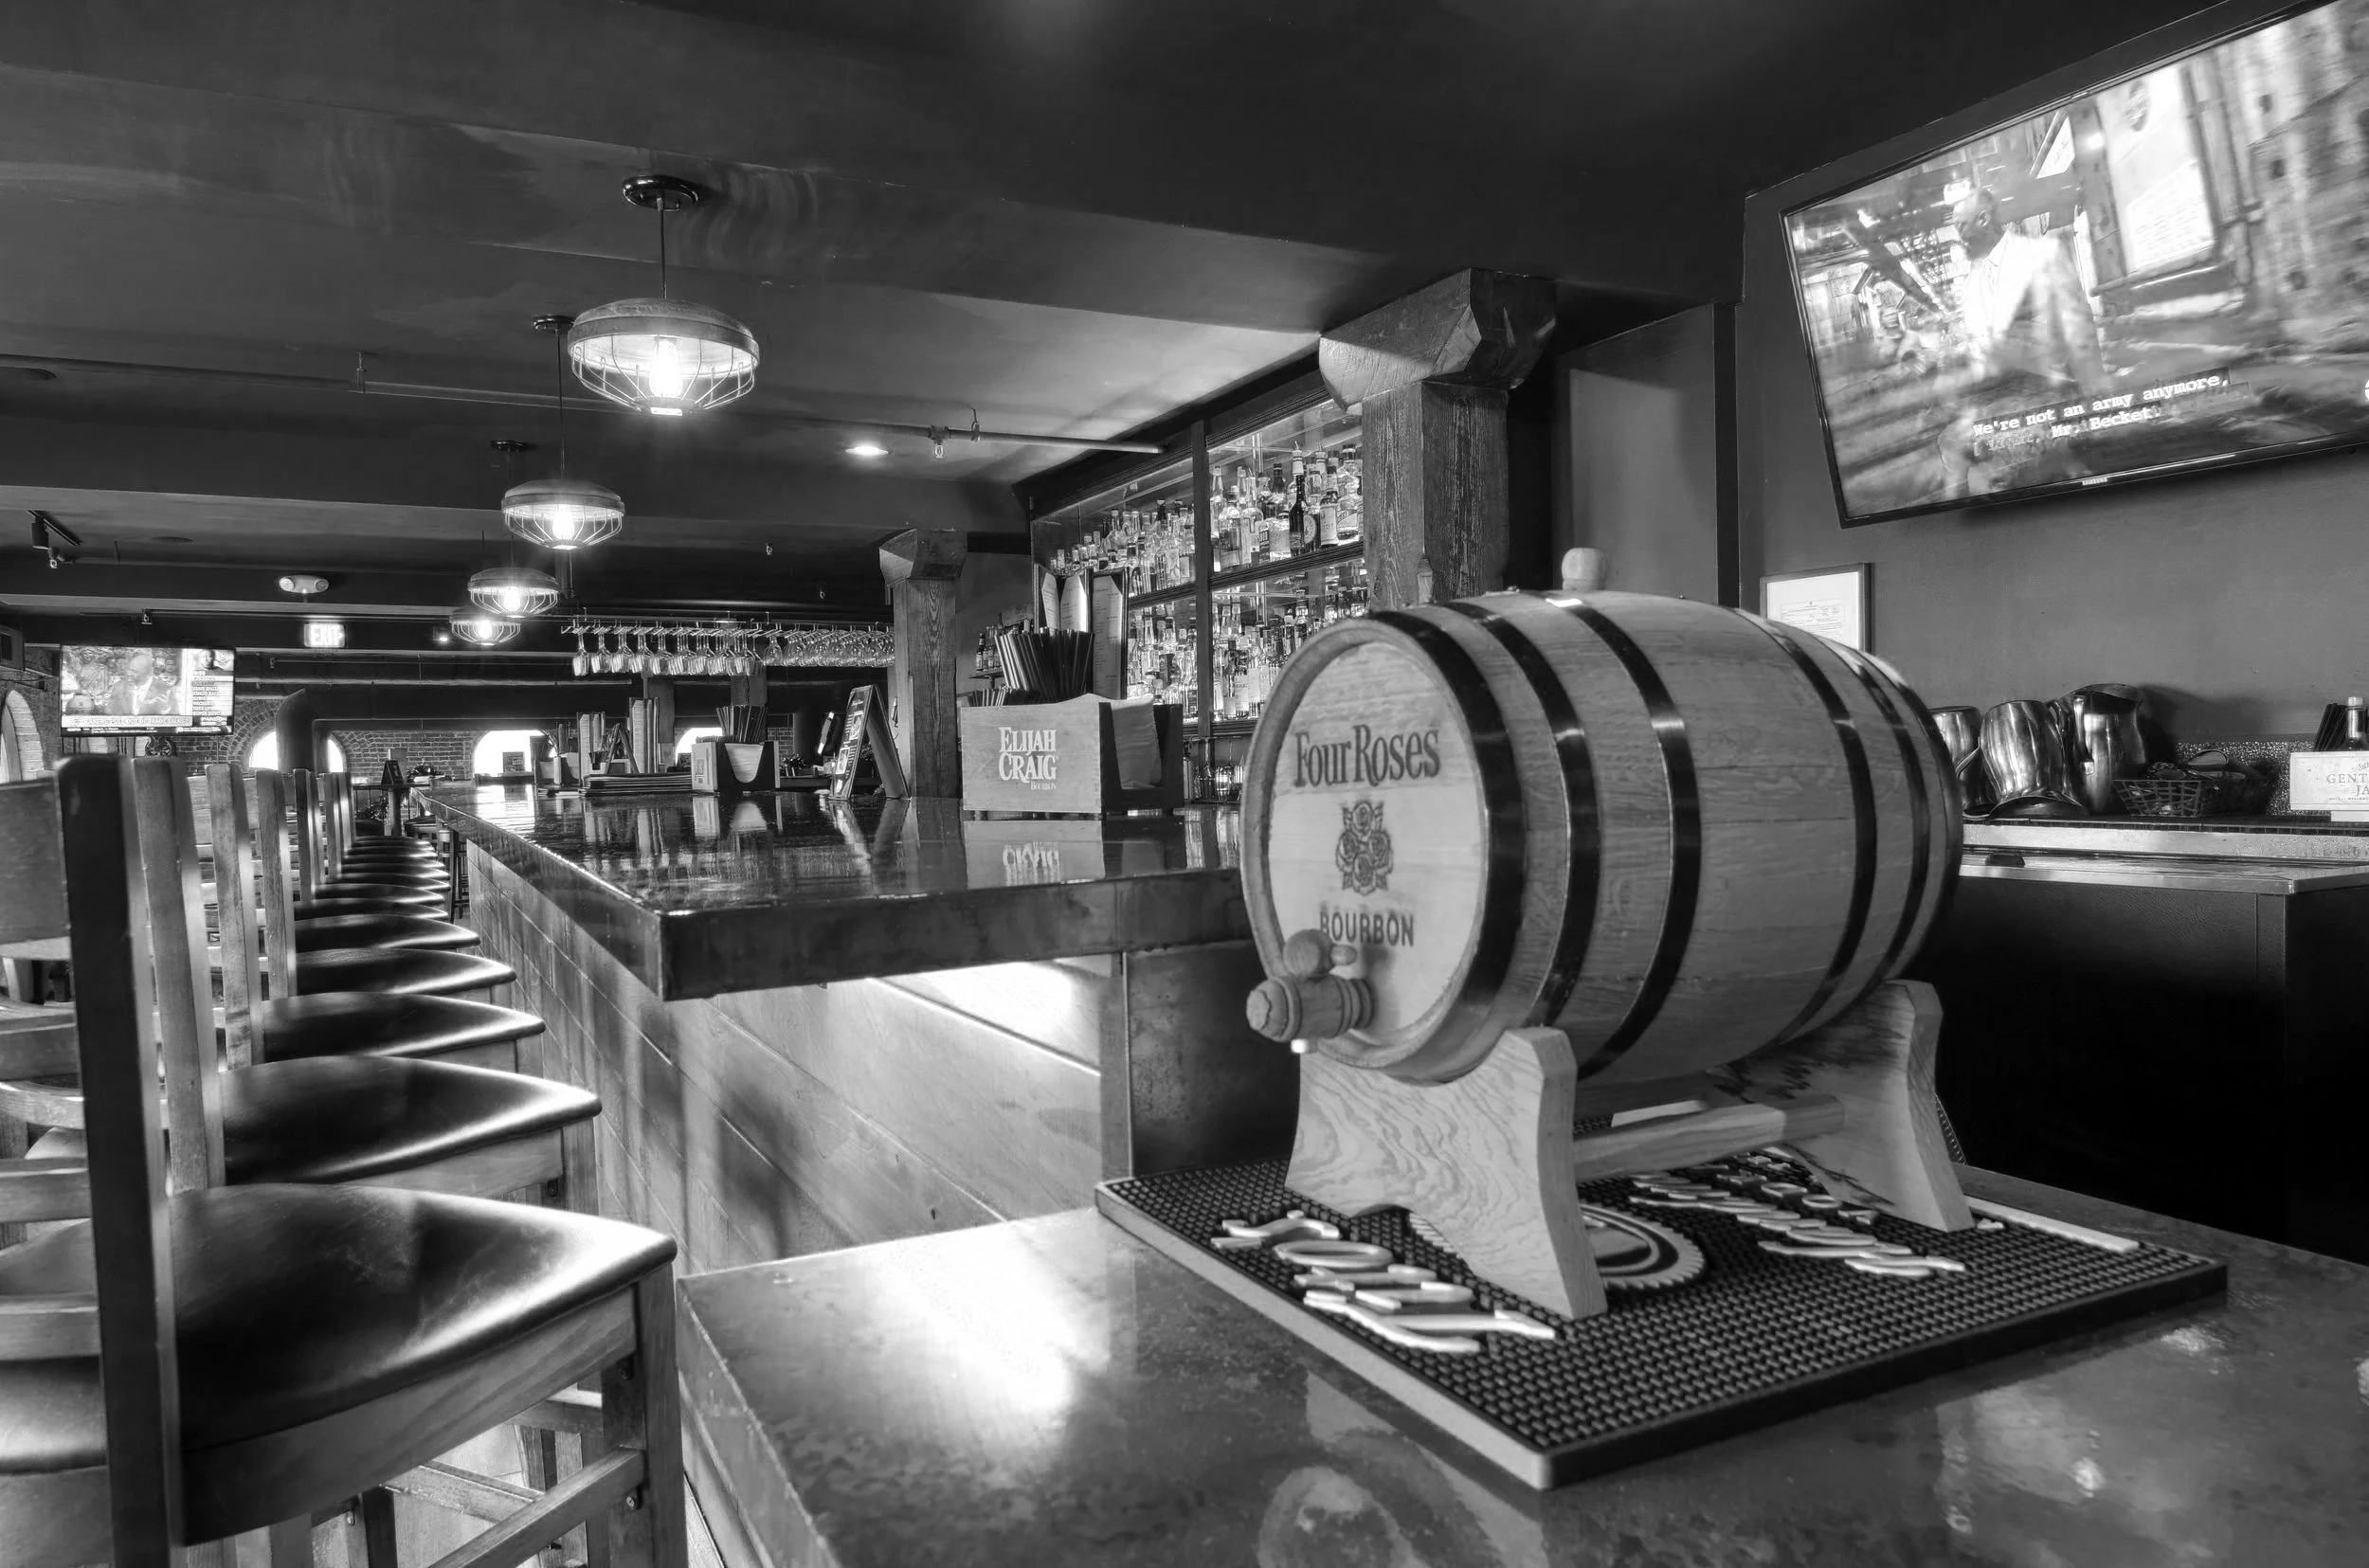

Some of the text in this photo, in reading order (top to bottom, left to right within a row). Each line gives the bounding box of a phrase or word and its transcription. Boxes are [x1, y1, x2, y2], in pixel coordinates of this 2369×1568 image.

[1973, 375, 2230, 436] We're not an army anymore,
[311, 624, 340, 646] EXIT
[998, 727, 1057, 755] ELIJAH
[1353, 724, 1441, 787] Roses
[998, 751, 1058, 784] CRAIG
[2326, 773, 2369, 784] GENT
[1320, 910, 1415, 946] BOURBON
[1210, 1209, 1556, 1353] Tito's
